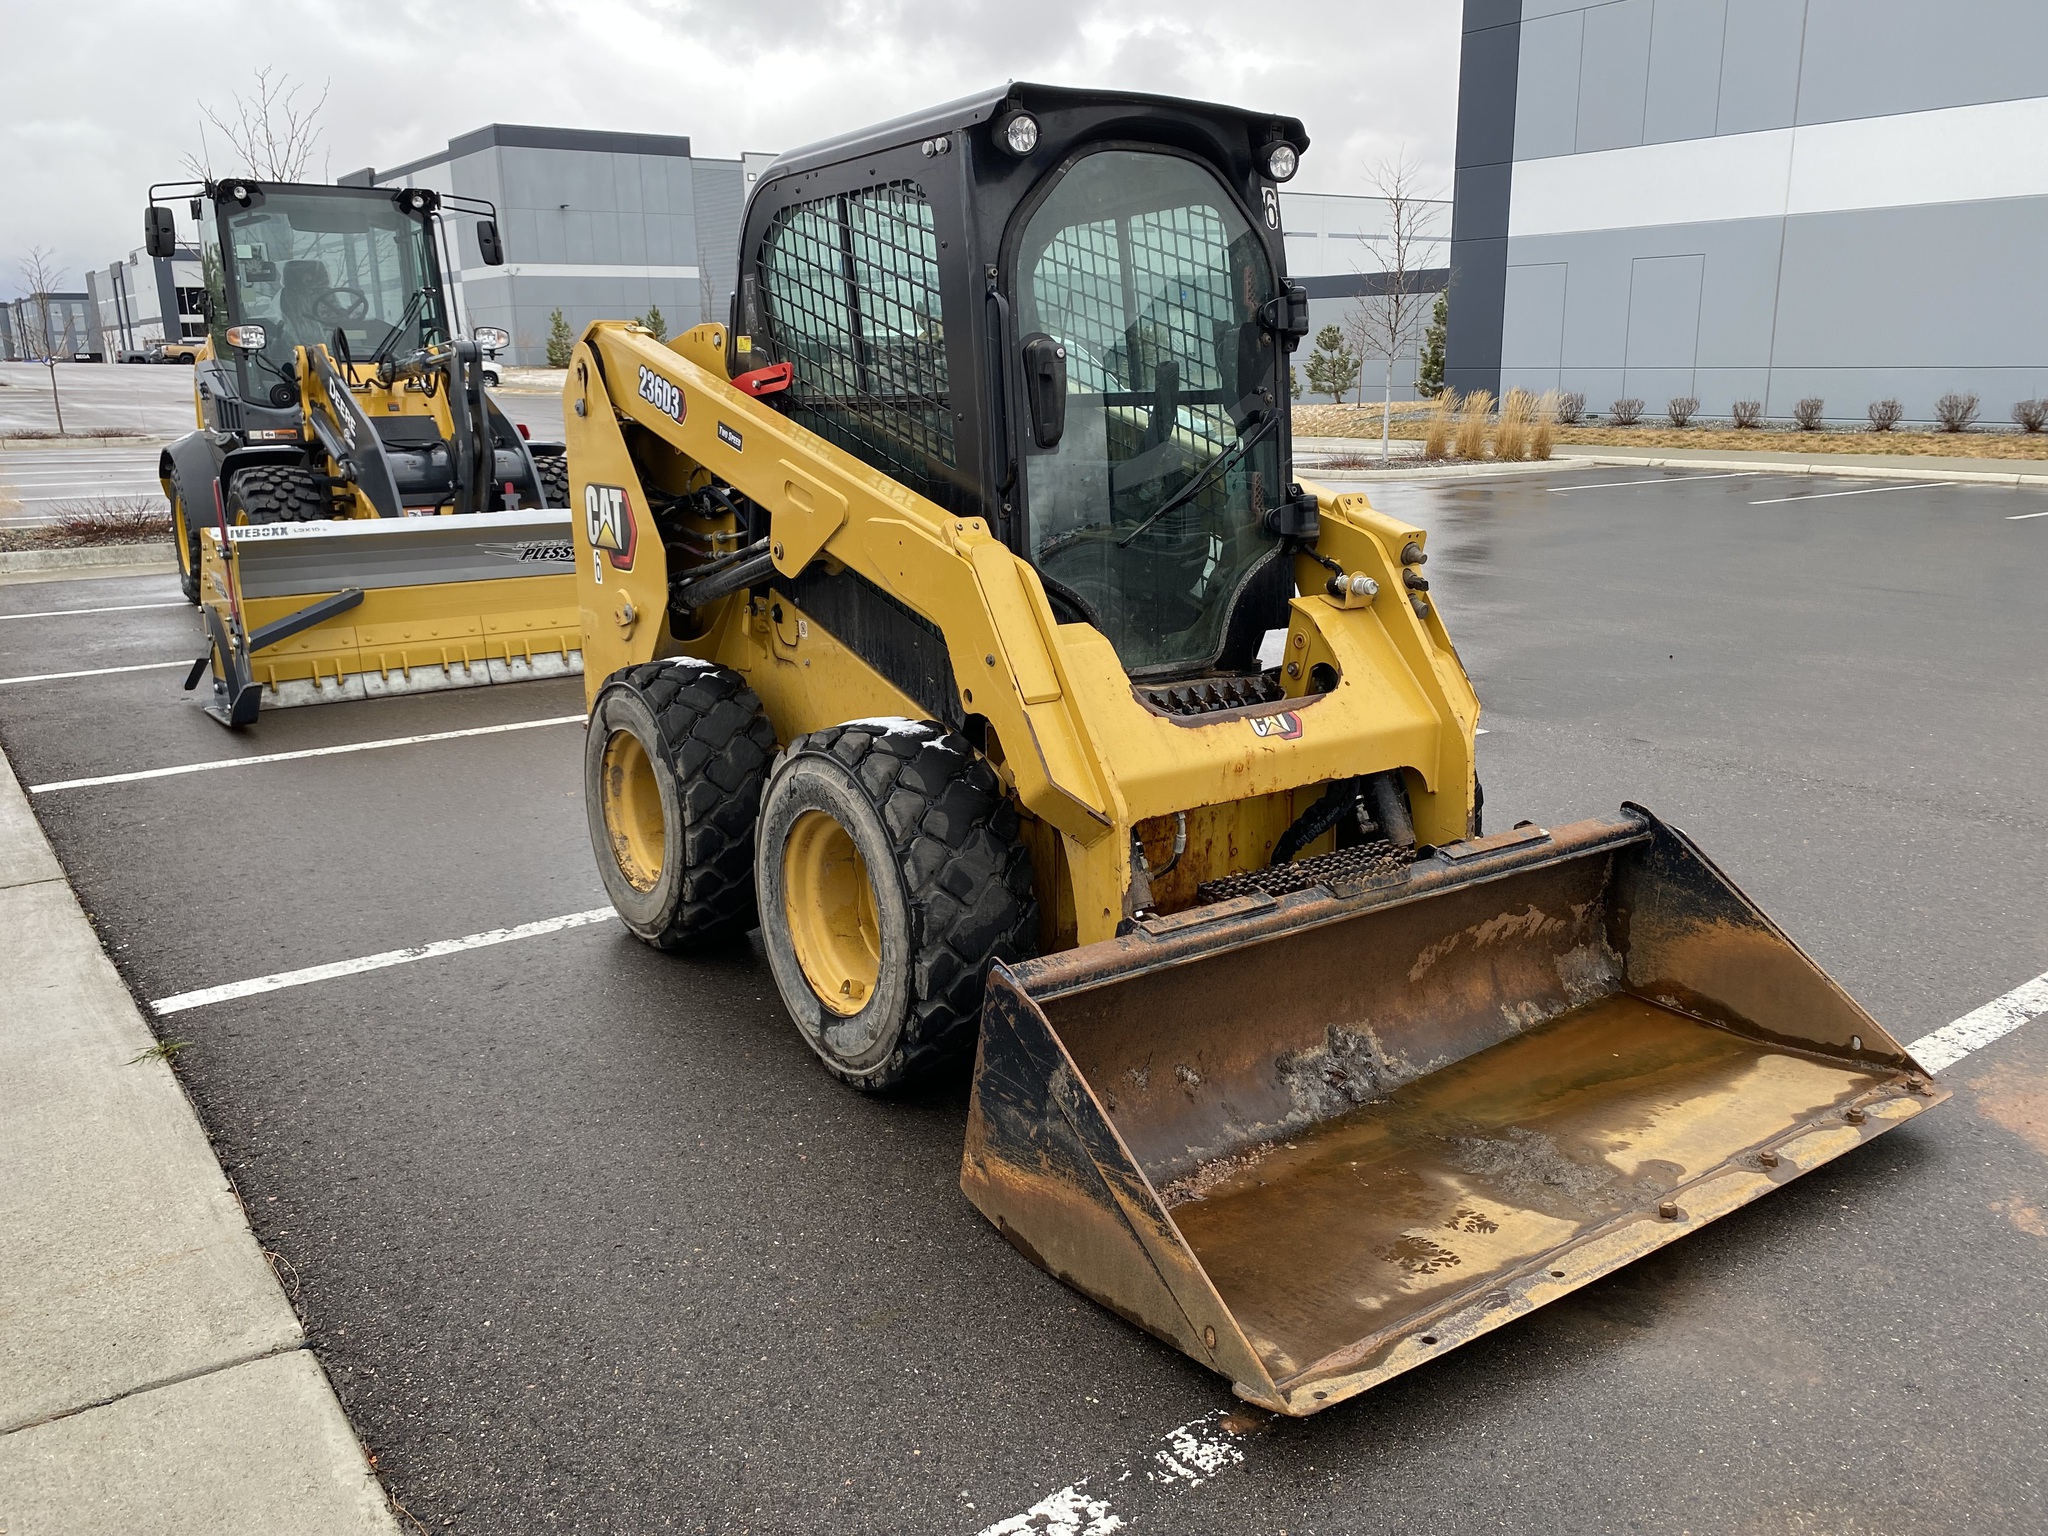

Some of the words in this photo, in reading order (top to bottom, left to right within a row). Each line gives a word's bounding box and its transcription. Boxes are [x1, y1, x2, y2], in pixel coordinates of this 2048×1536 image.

[1264, 189, 1277, 229] 6
[329, 376, 356, 437] DEERE
[639, 365, 681, 419] 236D3
[229, 527, 288, 539] IVEBOXX
[585, 485, 623, 549] CAT
[595, 551, 602, 583] 6
